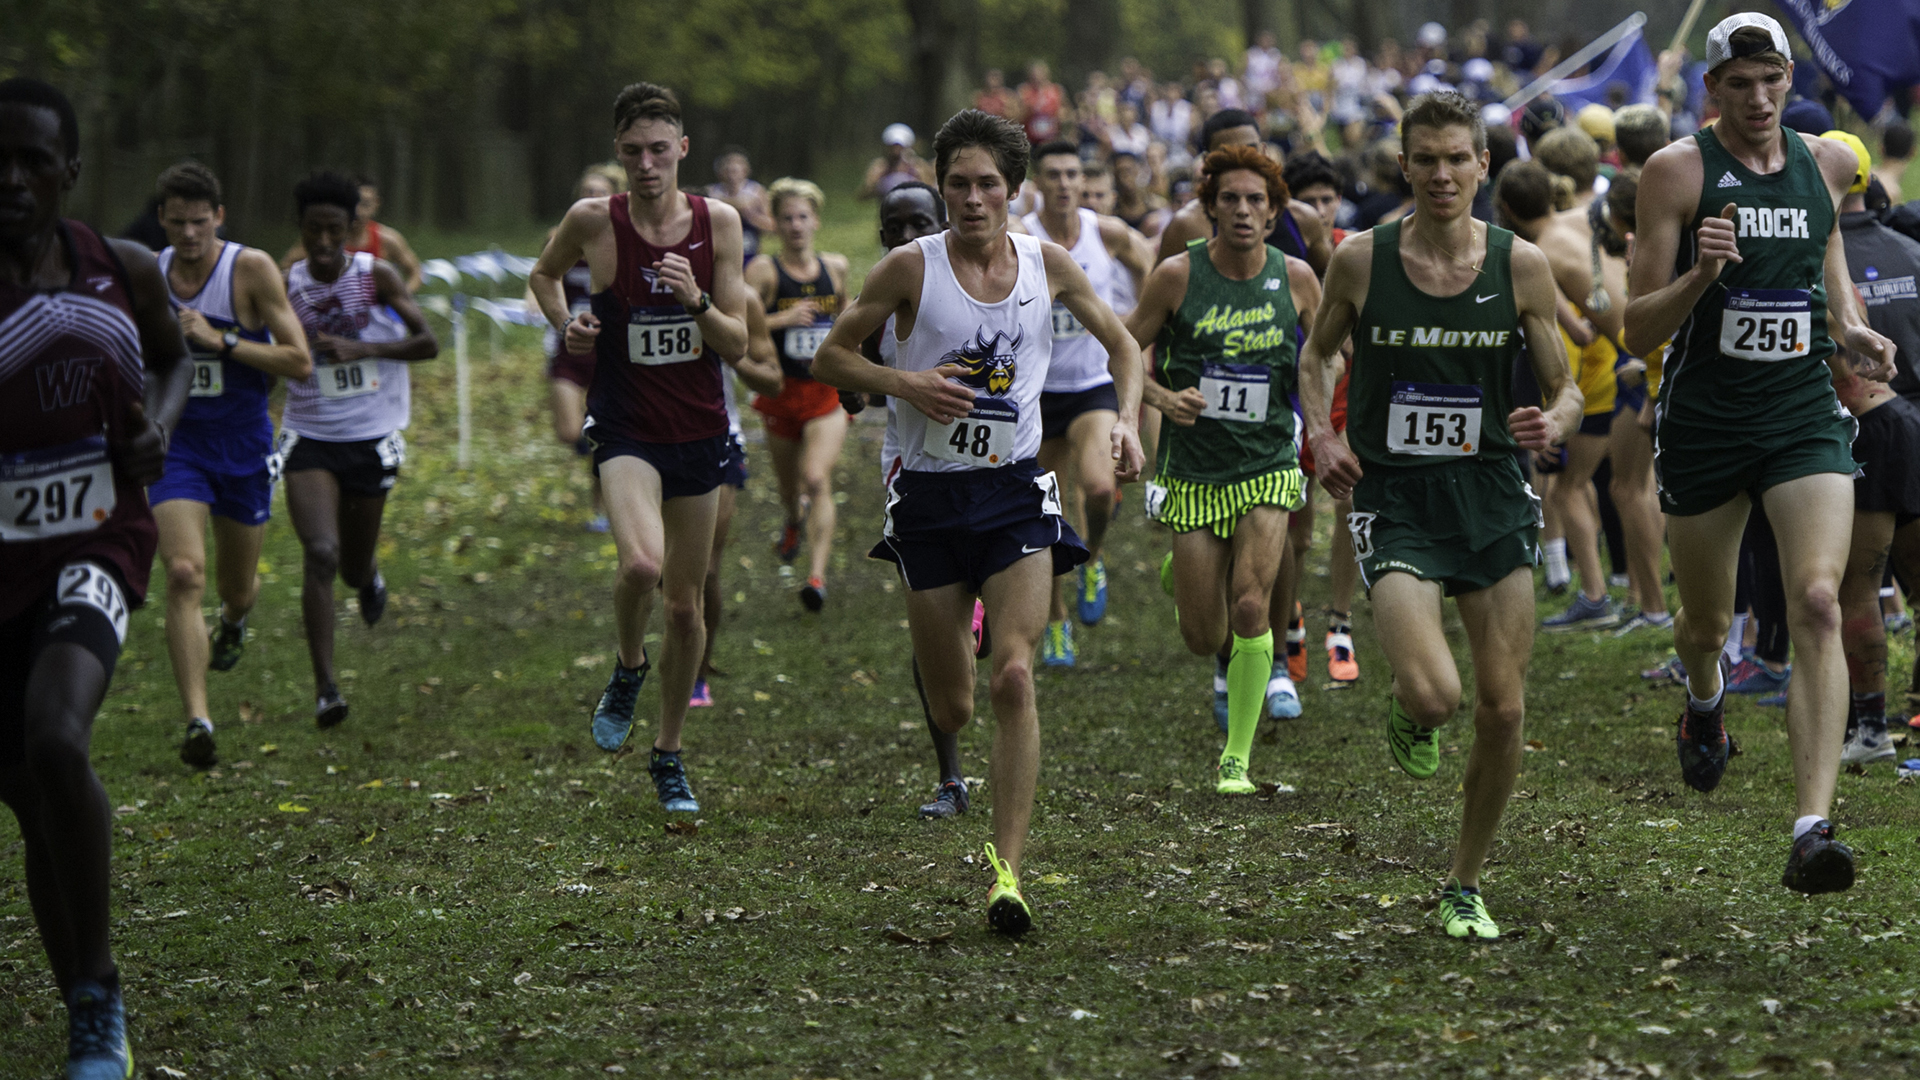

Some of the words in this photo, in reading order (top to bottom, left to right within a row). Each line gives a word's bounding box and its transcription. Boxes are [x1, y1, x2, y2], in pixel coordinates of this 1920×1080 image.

[1717, 180, 1742, 188] adidas
[1737, 207, 1810, 239] ROCK
[1193, 301, 1276, 339] Adams
[1734, 317, 1798, 353] 259
[641, 327, 691, 356] 158
[1223, 325, 1284, 357] State
[1371, 326, 1406, 346] LE
[1411, 327, 1510, 348] MOYNE
[335, 366, 363, 390] 90
[1218, 385, 1247, 413] 11
[949, 422, 991, 457] 48
[1404, 411, 1467, 447] 153
[14, 474, 92, 527] 297
